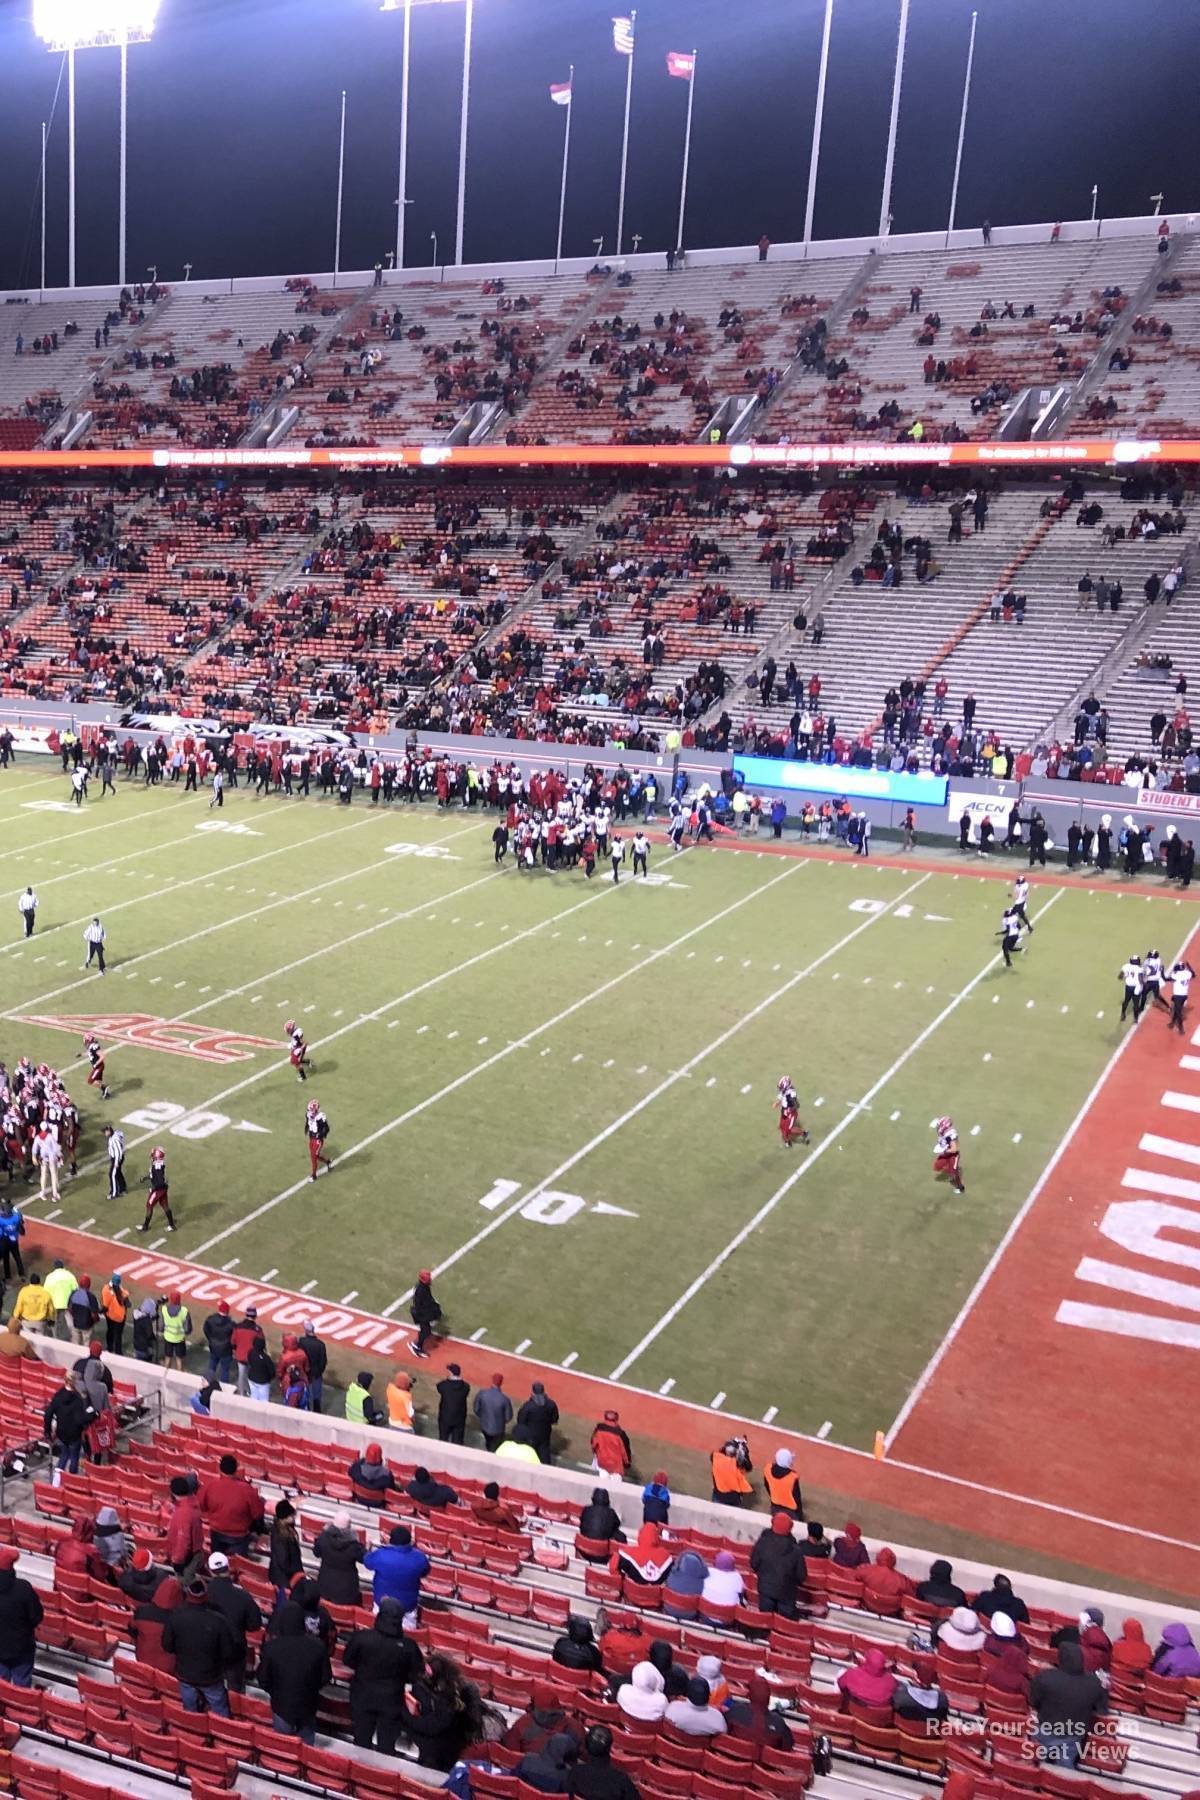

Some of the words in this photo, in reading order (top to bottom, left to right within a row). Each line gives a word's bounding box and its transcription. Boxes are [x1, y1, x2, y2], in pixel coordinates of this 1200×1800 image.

[961, 801, 1006, 813] ACCN
[1141, 792, 1193, 806] STUDENT
[5, 1013, 291, 1064] ACC
[121, 1102, 231, 1138] 20
[479, 1178, 586, 1225] 10
[113, 1255, 409, 1354] 1PACK1GOAL
